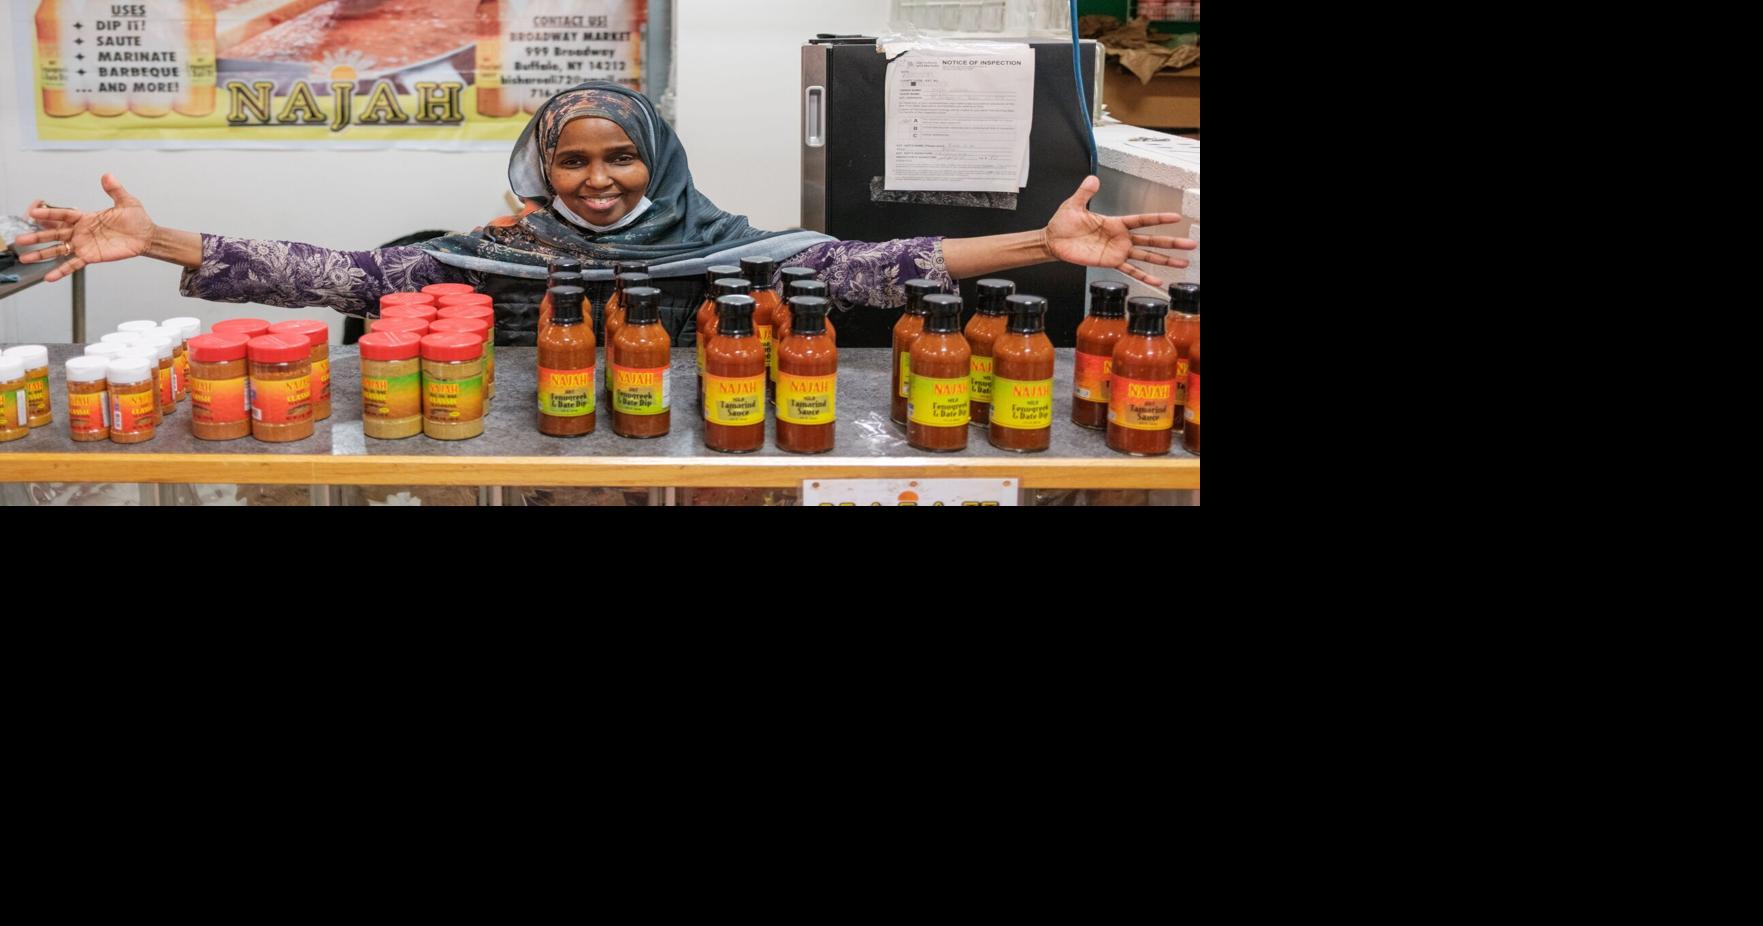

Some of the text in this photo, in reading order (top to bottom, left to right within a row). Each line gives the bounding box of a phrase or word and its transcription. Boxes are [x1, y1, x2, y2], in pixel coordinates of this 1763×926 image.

[111, 4, 147, 17] USES
[96, 20, 147, 31] DIP IT!
[533, 15, 585, 28] CONTACT
[96, 36, 142, 47] SAUTE
[510, 32, 632, 42] BROADWAY MARKET
[98, 51, 177, 62] MARINATE
[525, 46, 616, 59] 999 Broadway
[98, 66, 180, 78] BARBEQUE
[514, 60, 562, 73] Buffalo,
[567, 61, 584, 72] NY
[589, 61, 627, 72] 14212
[98, 82, 128, 93] AND
[132, 82, 180, 93] MORE!
[226, 81, 465, 132] NAJAH
[972, 361, 992, 372] NAJ
[551, 372, 588, 387] NAJAH
[618, 371, 654, 385] NAJAH
[720, 381, 757, 394] NAJAH
[790, 381, 828, 394] NAJAH
[1013, 385, 1049, 398] NAJAH
[1128, 383, 1170, 399] NAJAH
[551, 393, 587, 402] Fenugreek
[576, 400, 588, 408] Dip
[639, 400, 652, 408] Dip
[721, 401, 756, 409] Tamarind
[791, 400, 827, 408] Tamarind
[1129, 404, 1167, 413] Tamarind
[728, 409, 750, 417] Sauce
[798, 408, 820, 416] Sauce
[940, 410, 957, 418] Date
[1020, 412, 1037, 420] Date
[1137, 412, 1160, 421] Sauce
